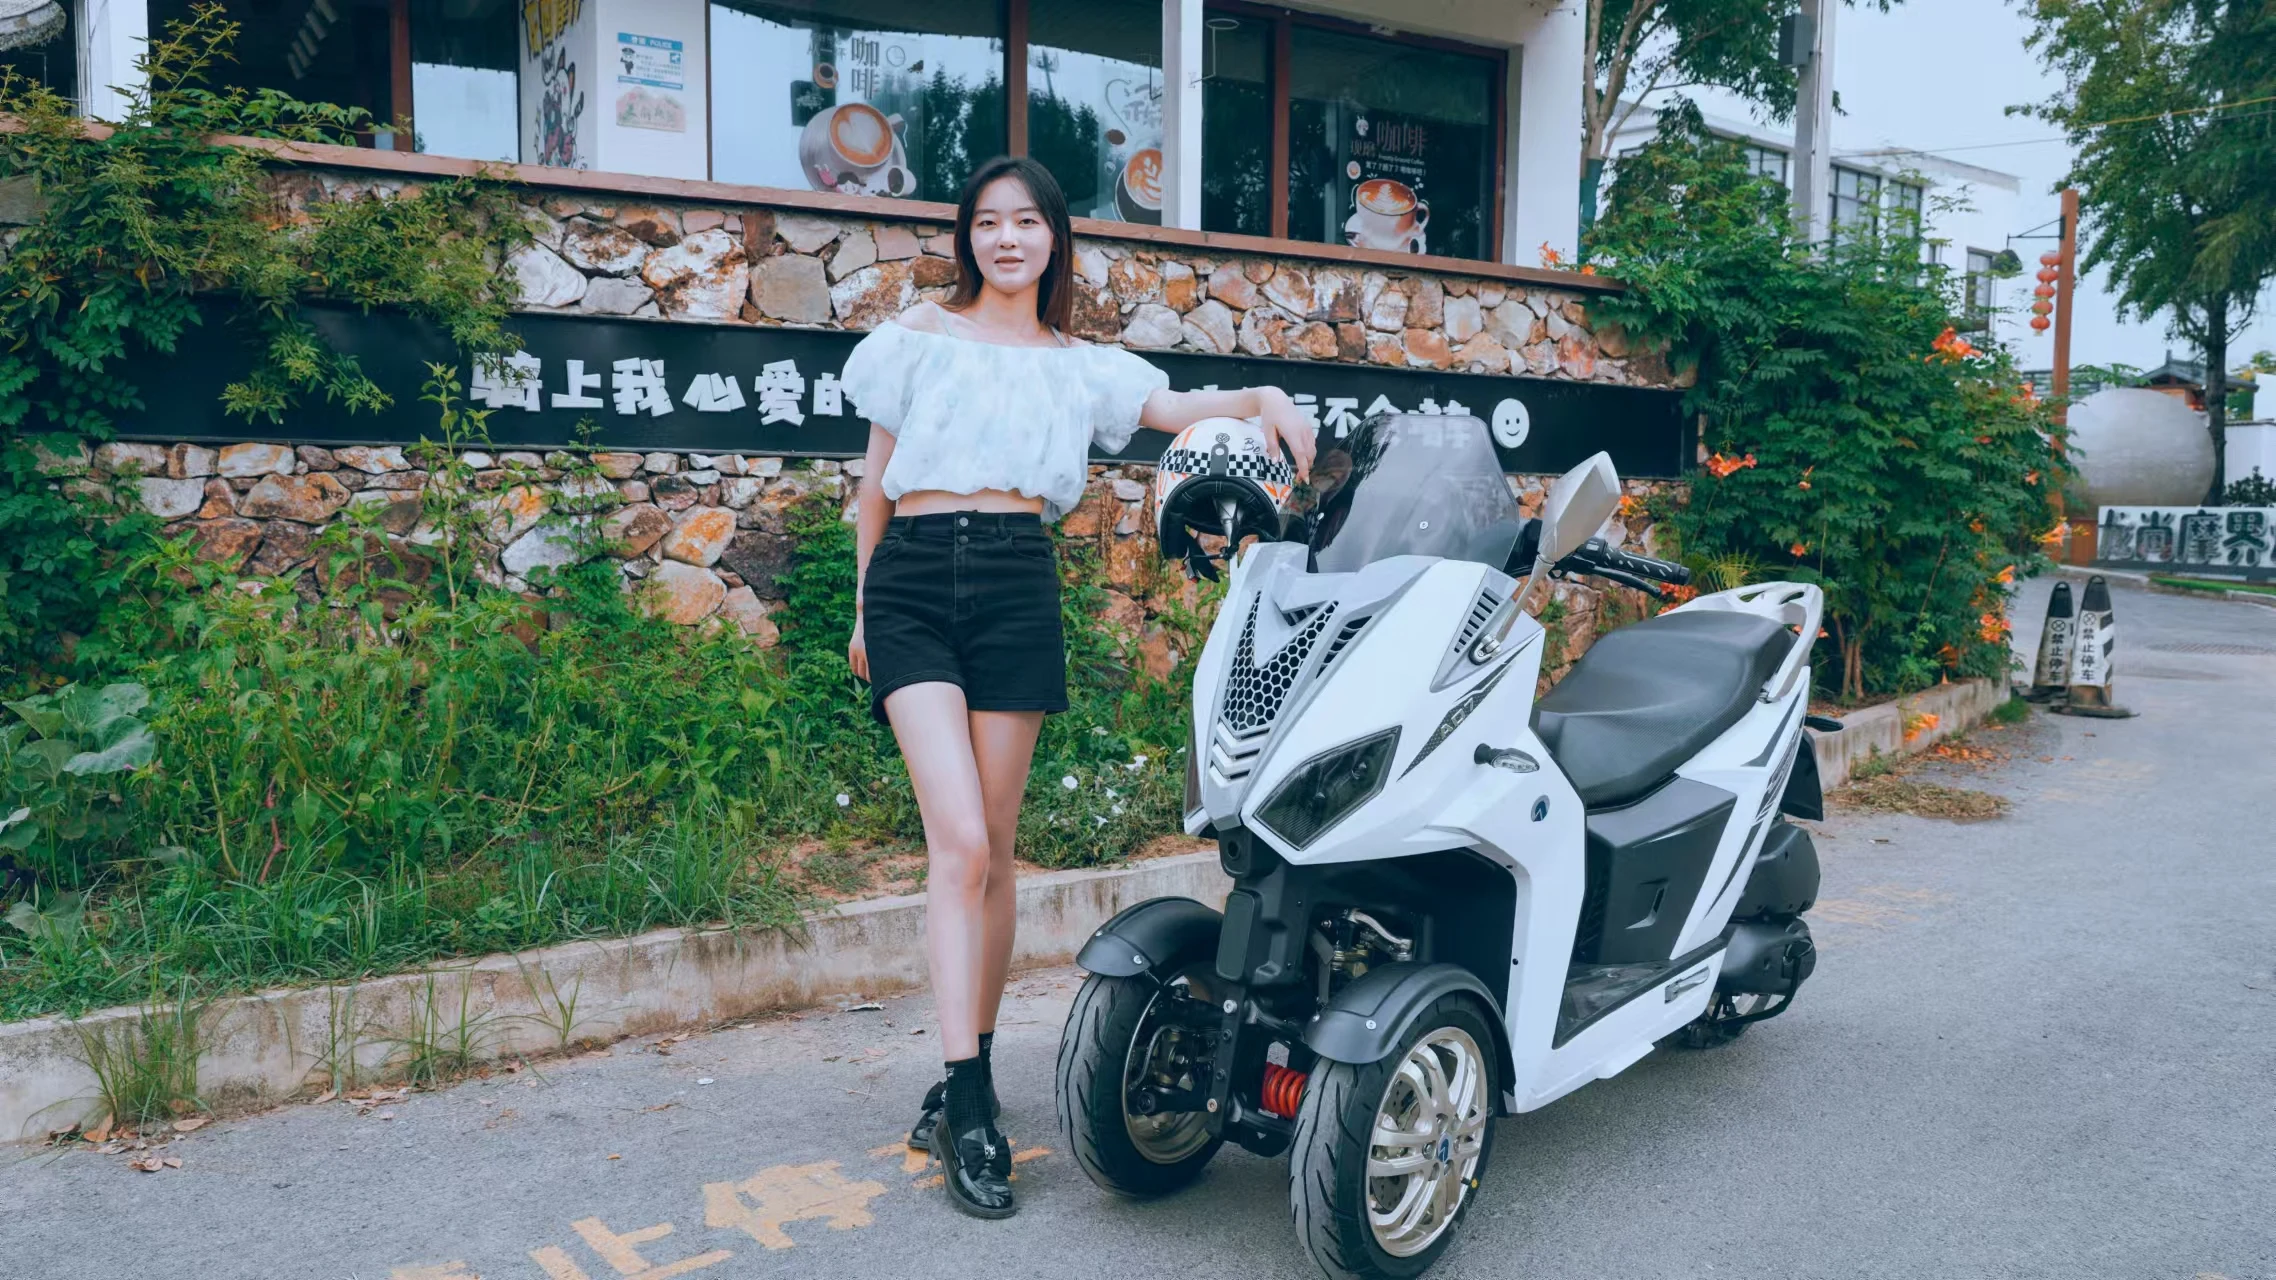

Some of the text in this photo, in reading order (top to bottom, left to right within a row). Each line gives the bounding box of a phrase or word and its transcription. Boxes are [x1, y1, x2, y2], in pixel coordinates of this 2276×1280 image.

[851, 36, 880, 100] 咖啡
[2049, 633, 2065, 682] 禁止停车
[2081, 628, 2096, 681] 禁止停车
